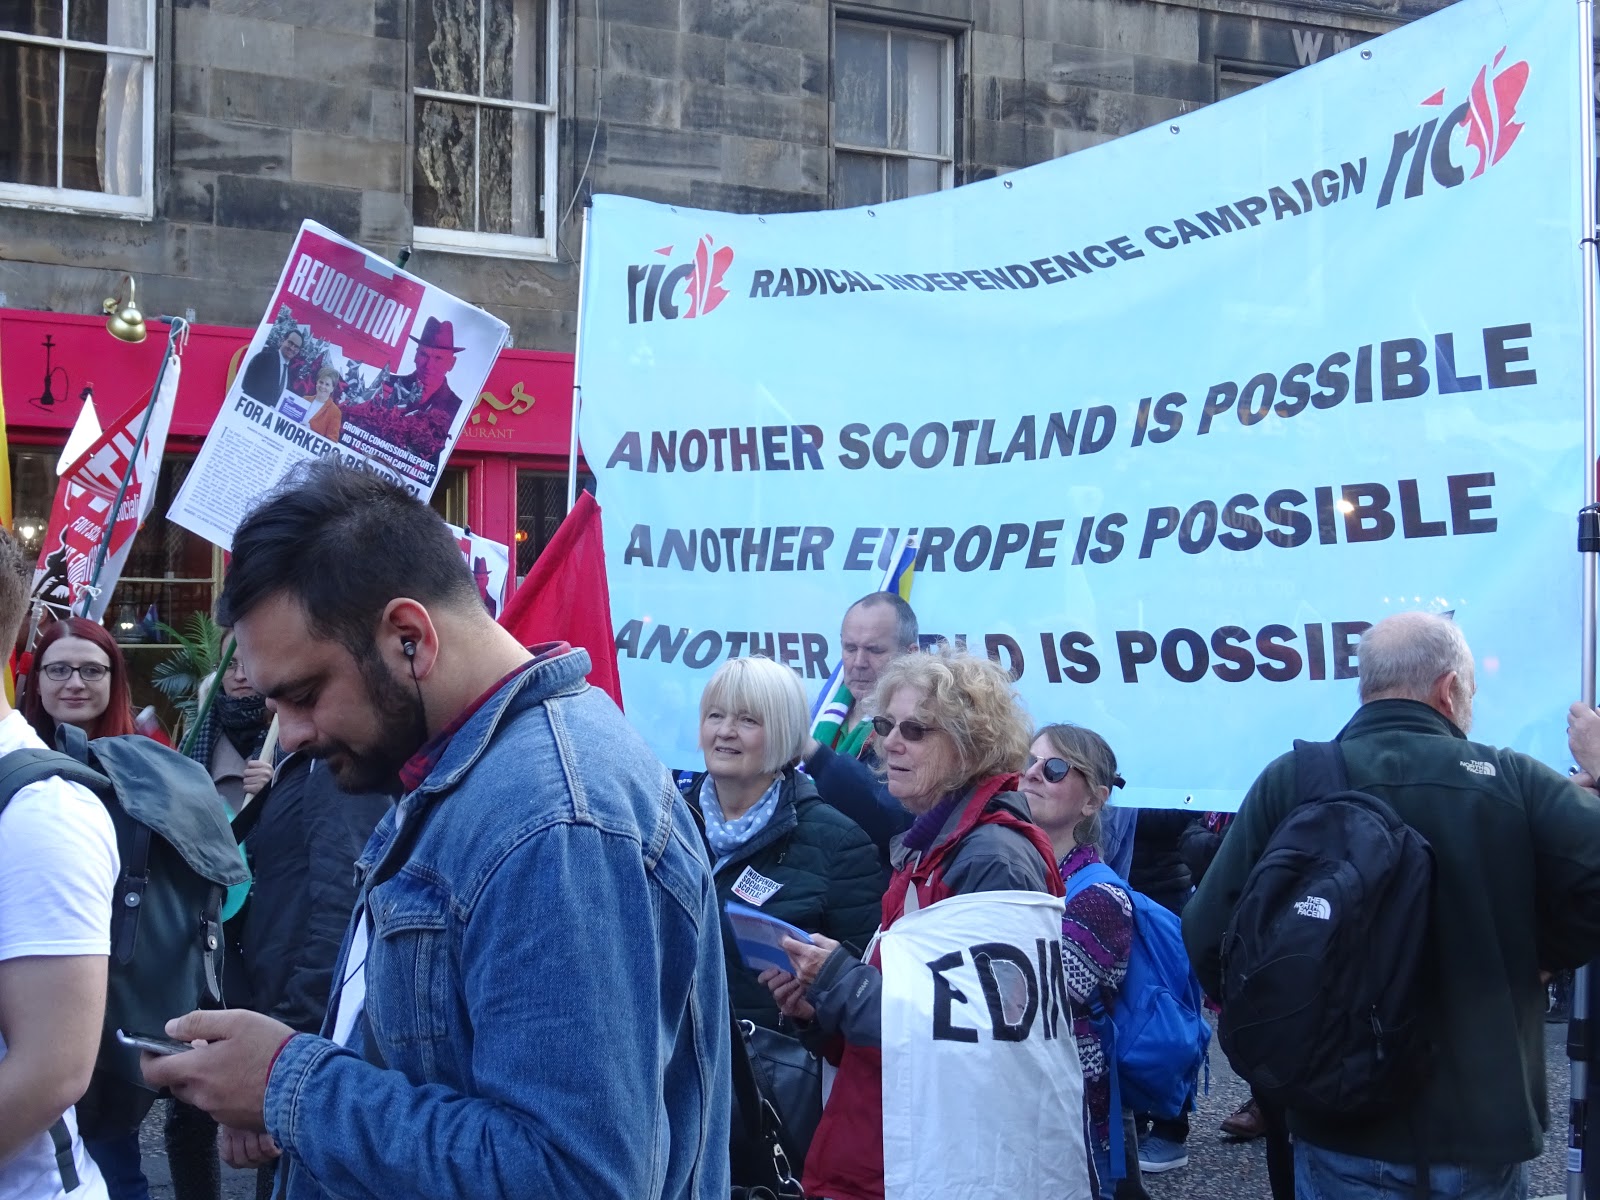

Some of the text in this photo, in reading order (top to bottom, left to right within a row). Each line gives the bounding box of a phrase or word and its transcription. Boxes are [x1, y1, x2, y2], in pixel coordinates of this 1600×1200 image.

[749, 157, 1368, 298] RADICAL INDEPENDENCE CAMPAIGN
[287, 252, 411, 348] REVOLUTION
[234, 396, 264, 424] FOR
[261, 412, 274, 429] A
[605, 323, 1538, 473] ANOTHER SCOTLAND IS POSSIBLE
[341, 433, 353, 444] NO
[351, 438, 361, 449] TO
[360, 442, 394, 463] SCOTTISH
[343, 421, 436, 472] GROWTH COMMISSION REPORT:
[462, 428, 515, 439] AURANT
[624, 523, 834, 573] ANOTHER
[1071, 512, 1128, 565] IS
[1138, 472, 1498, 560] POSSIBLE
[615, 619, 832, 679] ANOTHER
[1040, 631, 1101, 684] IS
[1115, 621, 1374, 684] POSSIB
[742, 874, 771, 894] SOCIALIST
[746, 868, 781, 890] INDEPENDEN
[1293, 901, 1319, 911] NORTH
[1297, 909, 1318, 918] FACE
[1306, 895, 1320, 904] THE
